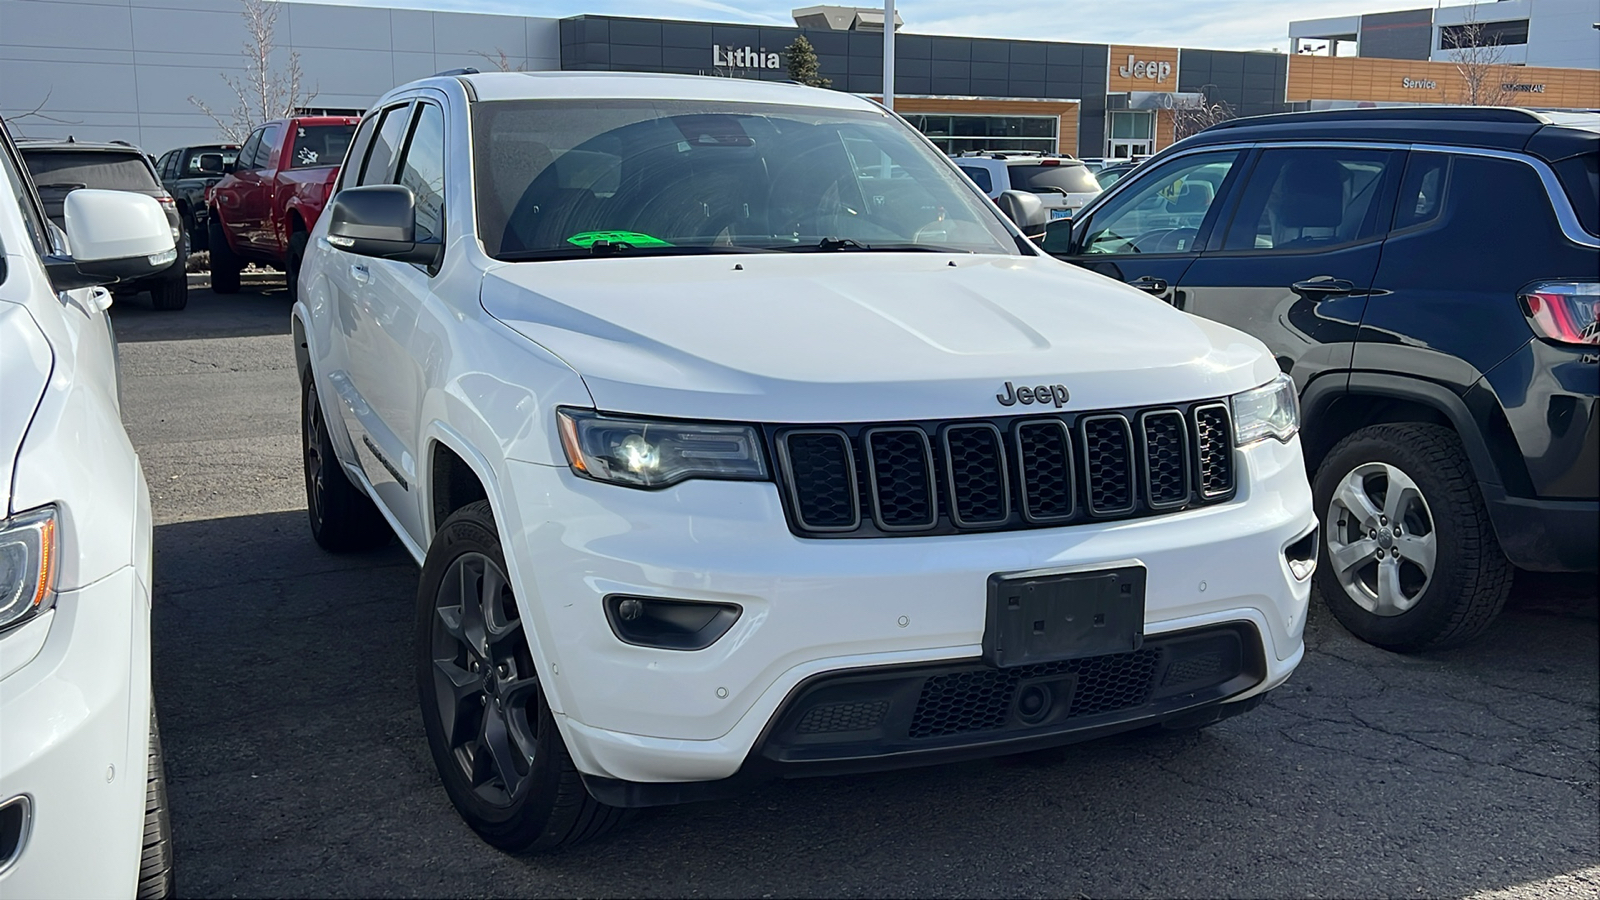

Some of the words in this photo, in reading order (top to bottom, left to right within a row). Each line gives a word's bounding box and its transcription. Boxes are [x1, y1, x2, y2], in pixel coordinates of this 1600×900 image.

[713, 44, 780, 69] Lithia
[1119, 54, 1171, 84] Jeep
[1402, 77, 1437, 90] Service
[996, 381, 1070, 409] Jeep
